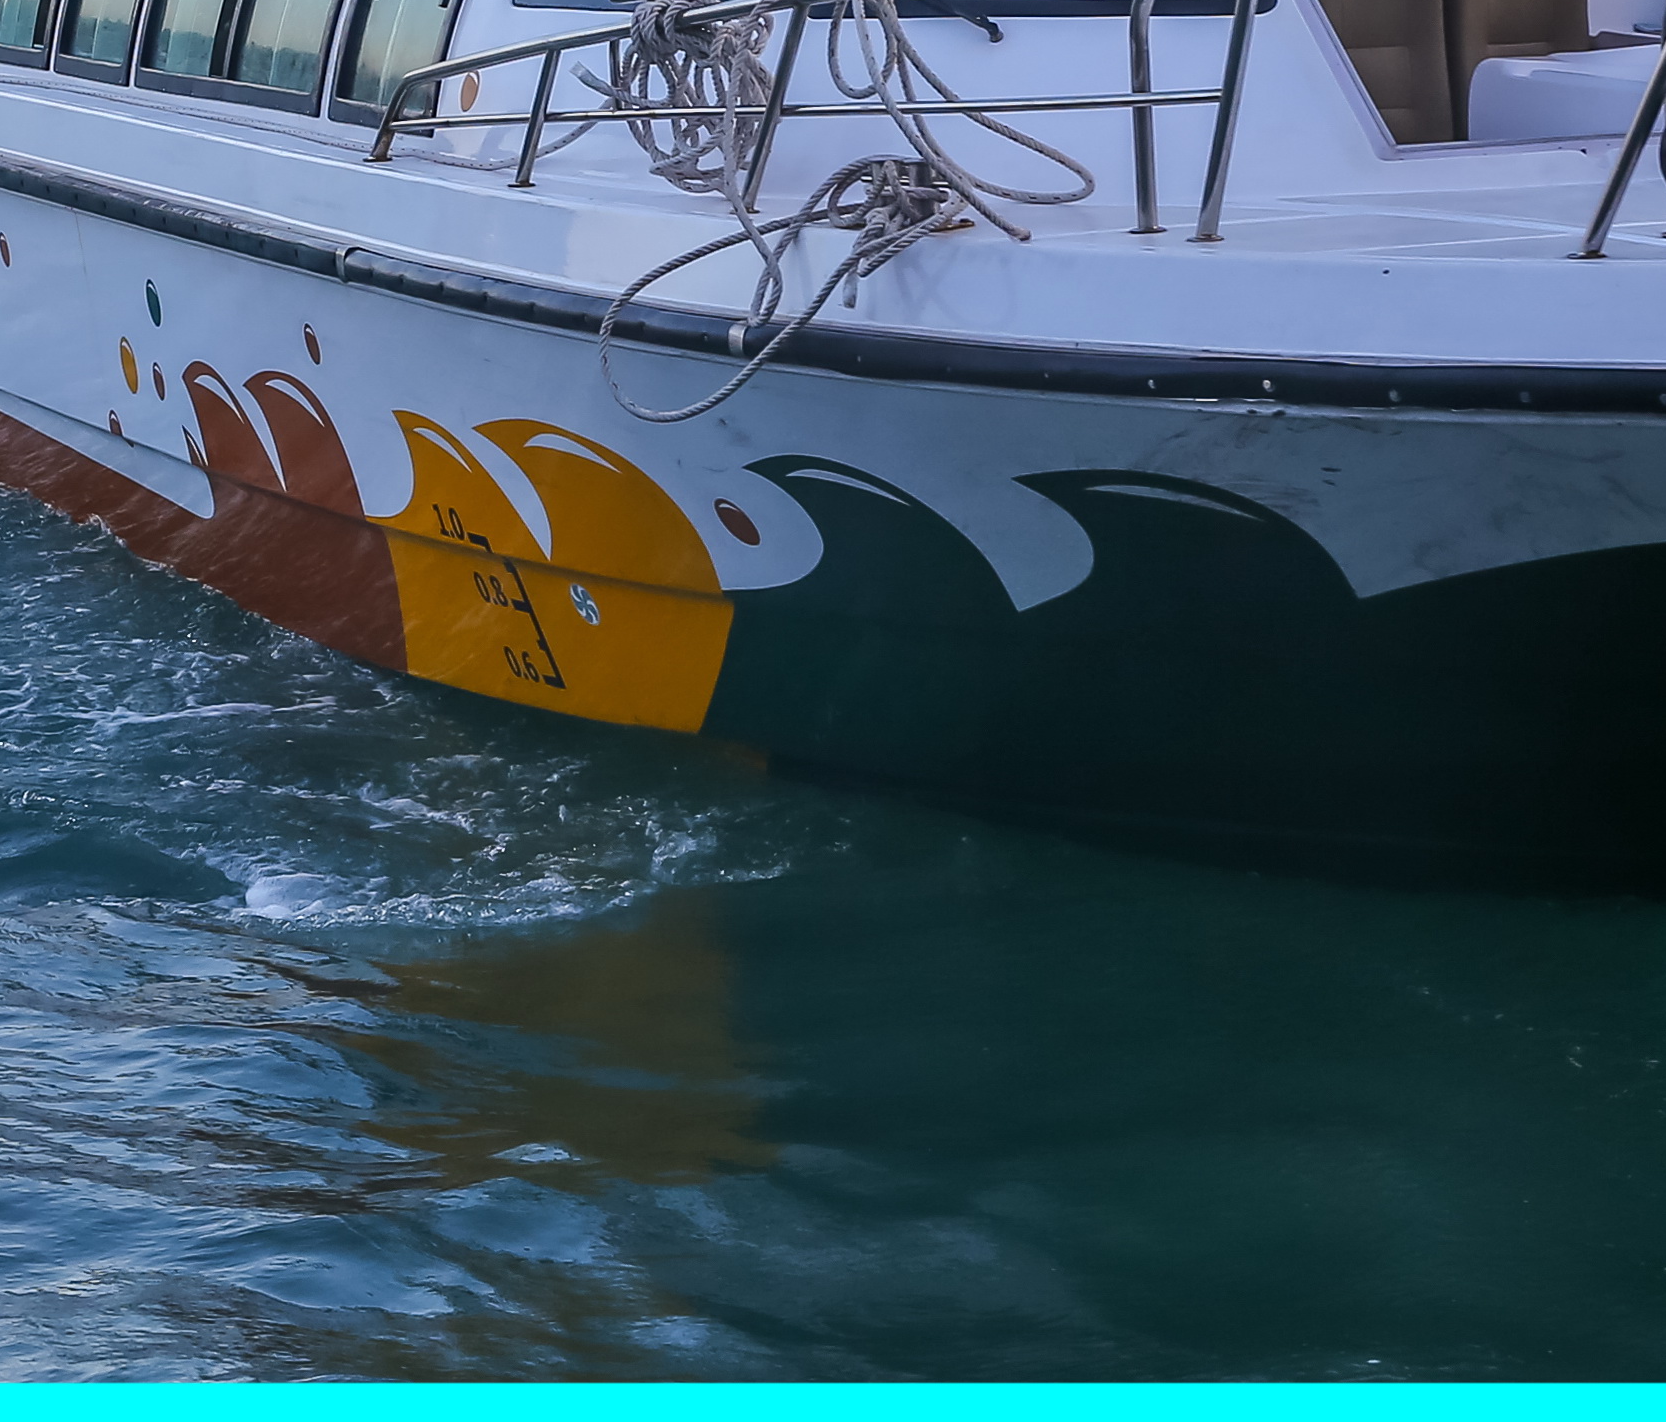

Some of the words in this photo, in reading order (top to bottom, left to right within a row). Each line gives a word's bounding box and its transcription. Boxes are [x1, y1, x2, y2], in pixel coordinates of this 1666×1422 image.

[432, 503, 465, 541] 1.0
[473, 570, 509, 608] 0.8
[503, 645, 540, 683] 0.6
